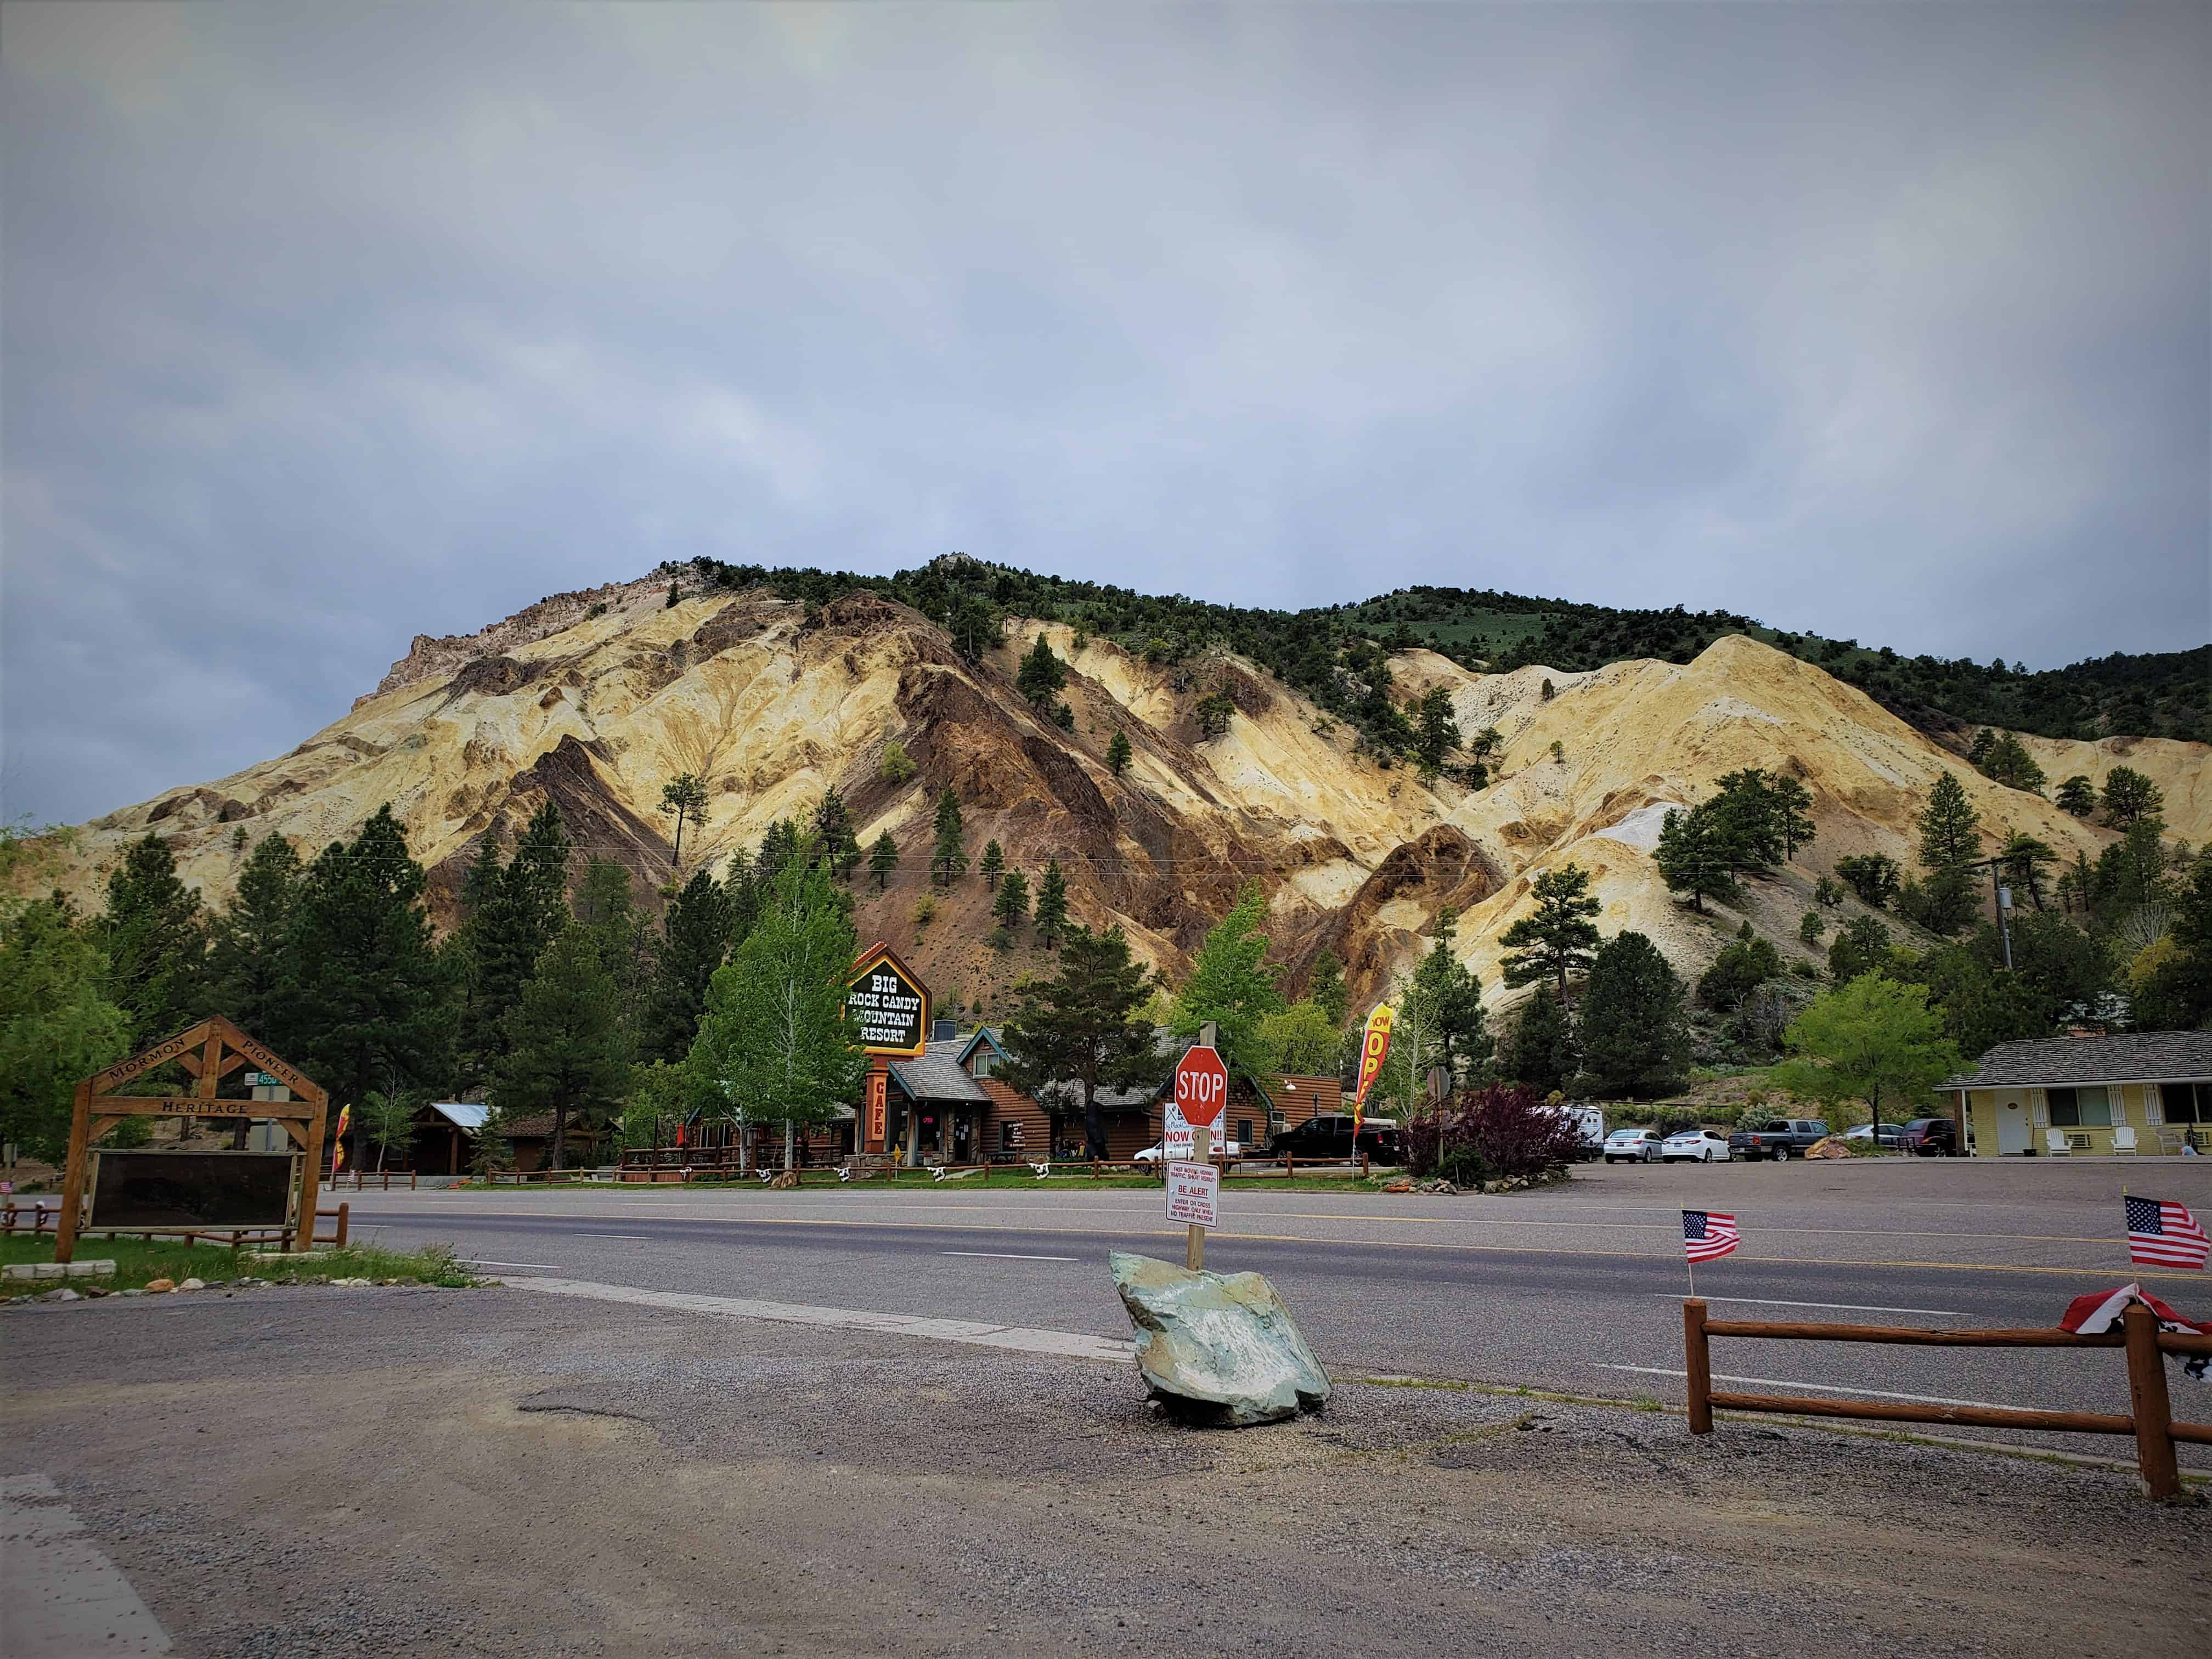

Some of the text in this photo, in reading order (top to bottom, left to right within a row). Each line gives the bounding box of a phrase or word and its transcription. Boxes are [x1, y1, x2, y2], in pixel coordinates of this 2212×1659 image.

[872, 975, 897, 994] BIG
[848, 992, 919, 1011] ROCK CANDY
[860, 1026, 906, 1042] RESORT
[109, 1037, 298, 1085] MORMON PIONEER
[1178, 1070, 1224, 1102] STOP
[162, 1101, 247, 1114] HERITAGE
[874, 1082, 884, 1135] CAFE
[1165, 1131, 1189, 1142] NOW
[1178, 1184, 1209, 1195] BE ALERT
[1171, 1204, 1190, 1212] HIGHWAY
